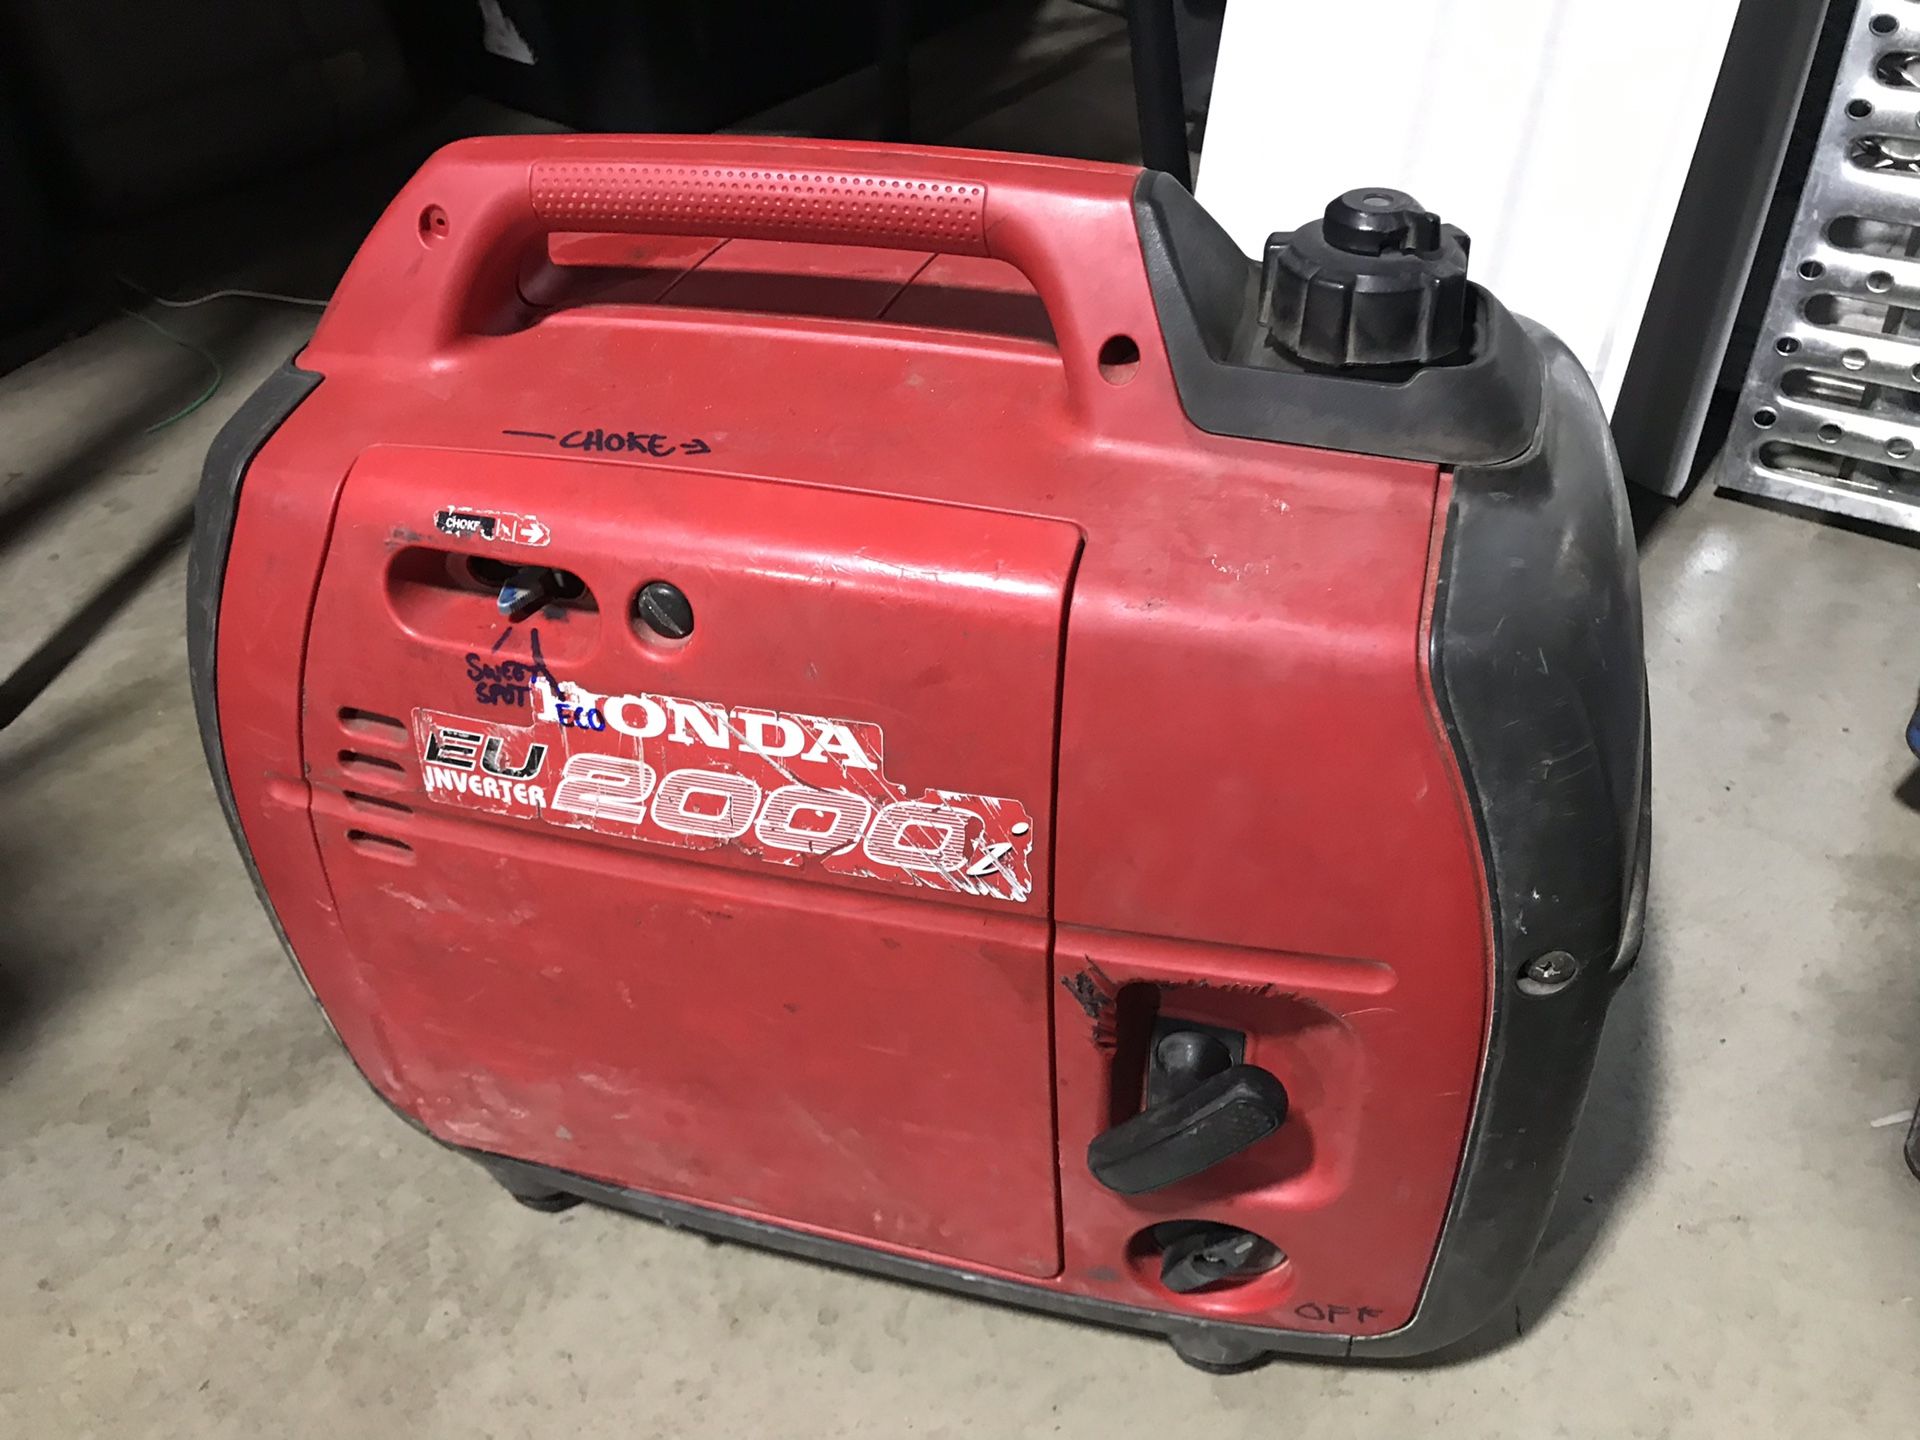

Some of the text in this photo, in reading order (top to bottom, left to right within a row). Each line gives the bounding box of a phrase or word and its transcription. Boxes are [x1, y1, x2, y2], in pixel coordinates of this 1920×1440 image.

[559, 429, 676, 457] CHOKE
[475, 682, 532, 708] SPOT
[555, 703, 606, 732] ECO
[424, 723, 549, 781] EU
[425, 765, 547, 809] INVERTER
[1294, 1302, 1383, 1324] OFF
